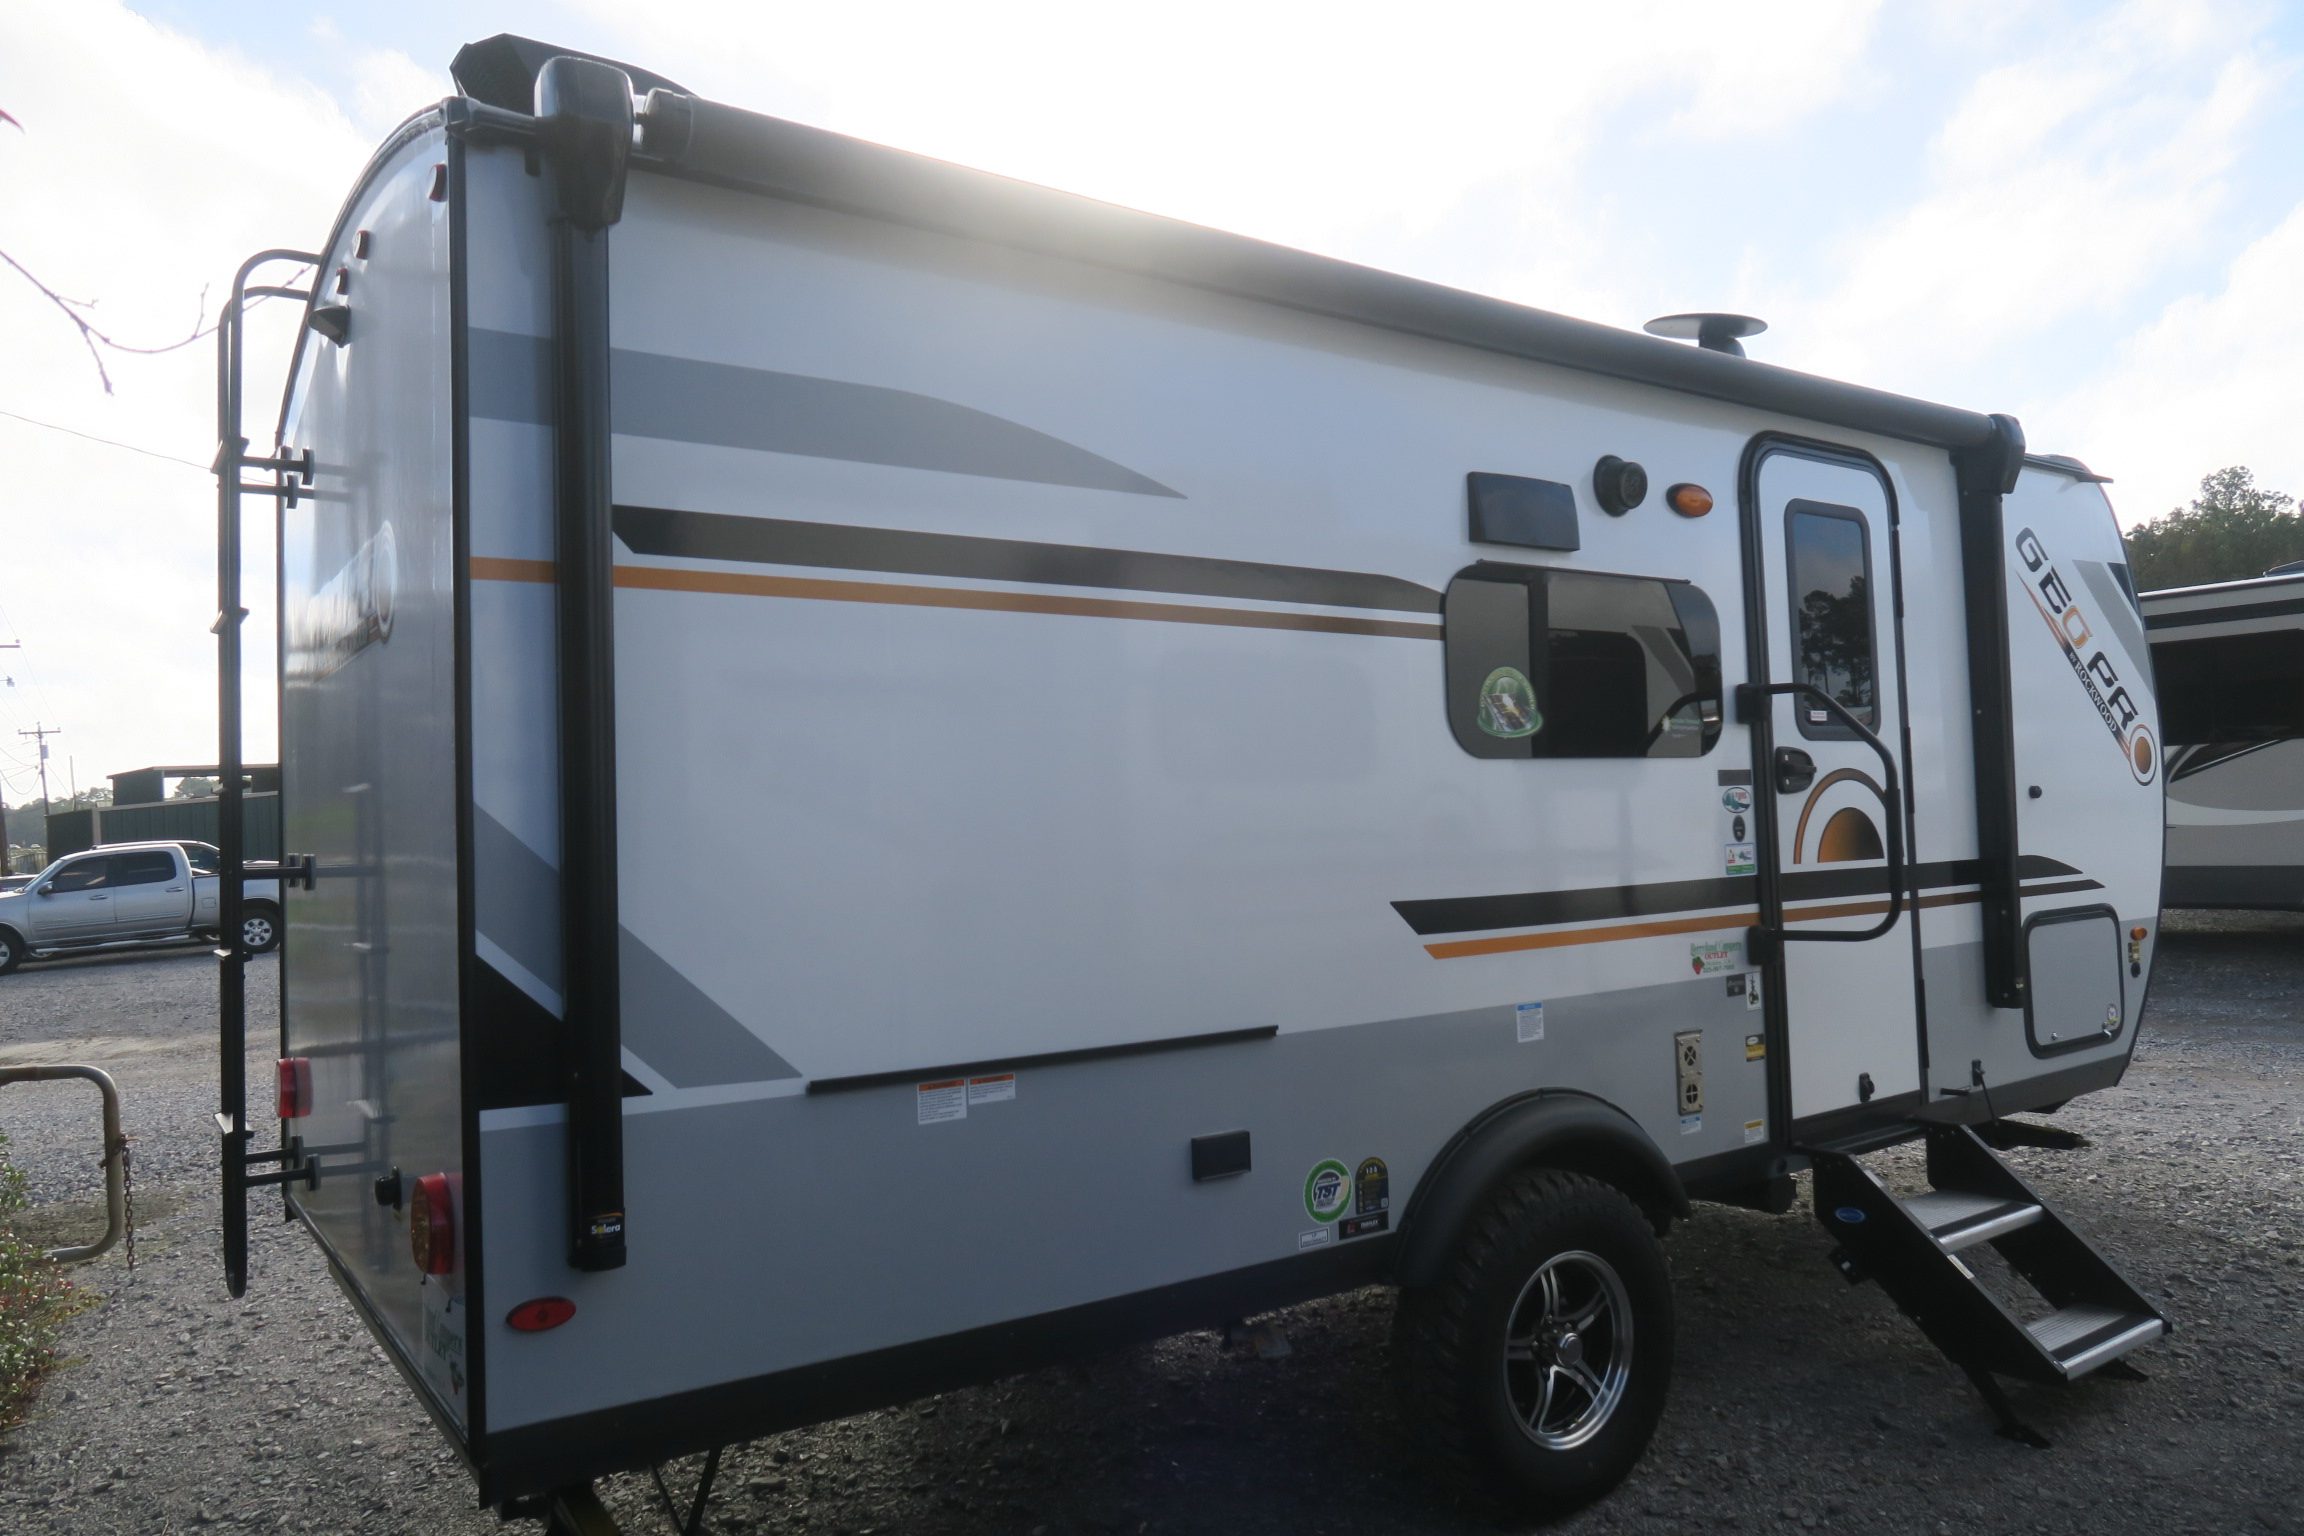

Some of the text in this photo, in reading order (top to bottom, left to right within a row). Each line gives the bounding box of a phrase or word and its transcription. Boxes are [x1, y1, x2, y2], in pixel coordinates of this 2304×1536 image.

[2015, 526, 2093, 649] GEO
[2069, 652, 2117, 732] BY ROCKWOOD
[1705, 952, 1728, 960] OUTLET
[1317, 1182, 1341, 1199] TST
[591, 1223, 621, 1235] Solera
